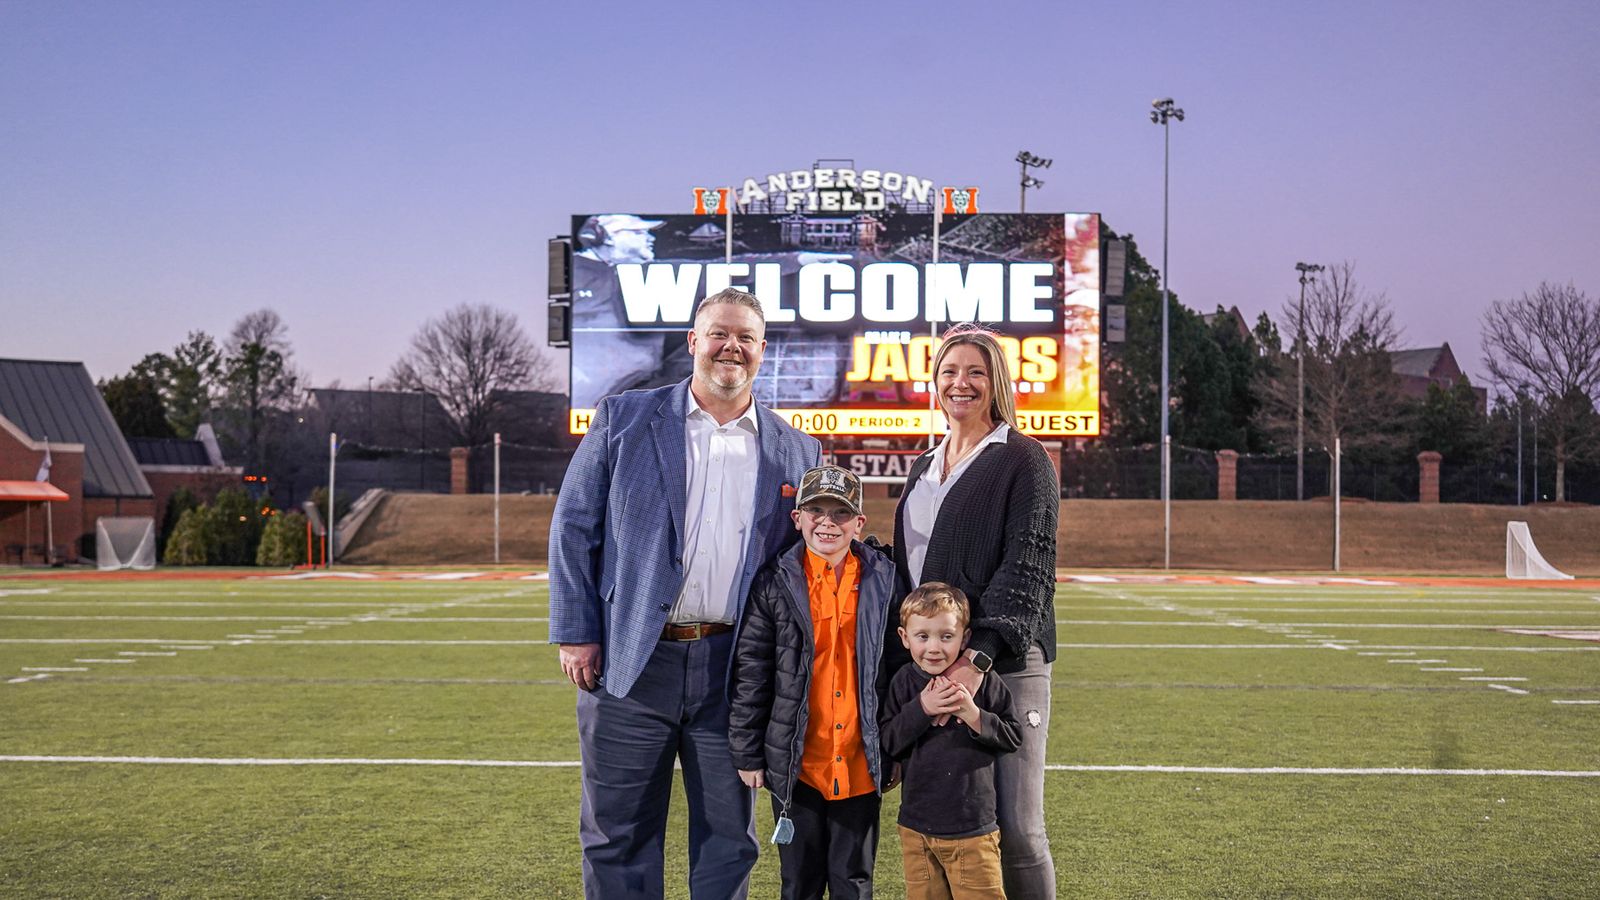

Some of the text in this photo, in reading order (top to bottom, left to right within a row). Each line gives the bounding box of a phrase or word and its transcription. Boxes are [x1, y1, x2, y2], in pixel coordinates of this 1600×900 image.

[740, 169, 933, 204] ANDERSON
[785, 191, 885, 211] FIELD
[616, 263, 1054, 322] WELCOME
[846, 336, 1057, 382] JACBS
[850, 417, 921, 427] PERIOD: 2
[1016, 415, 1093, 430] GUEST
